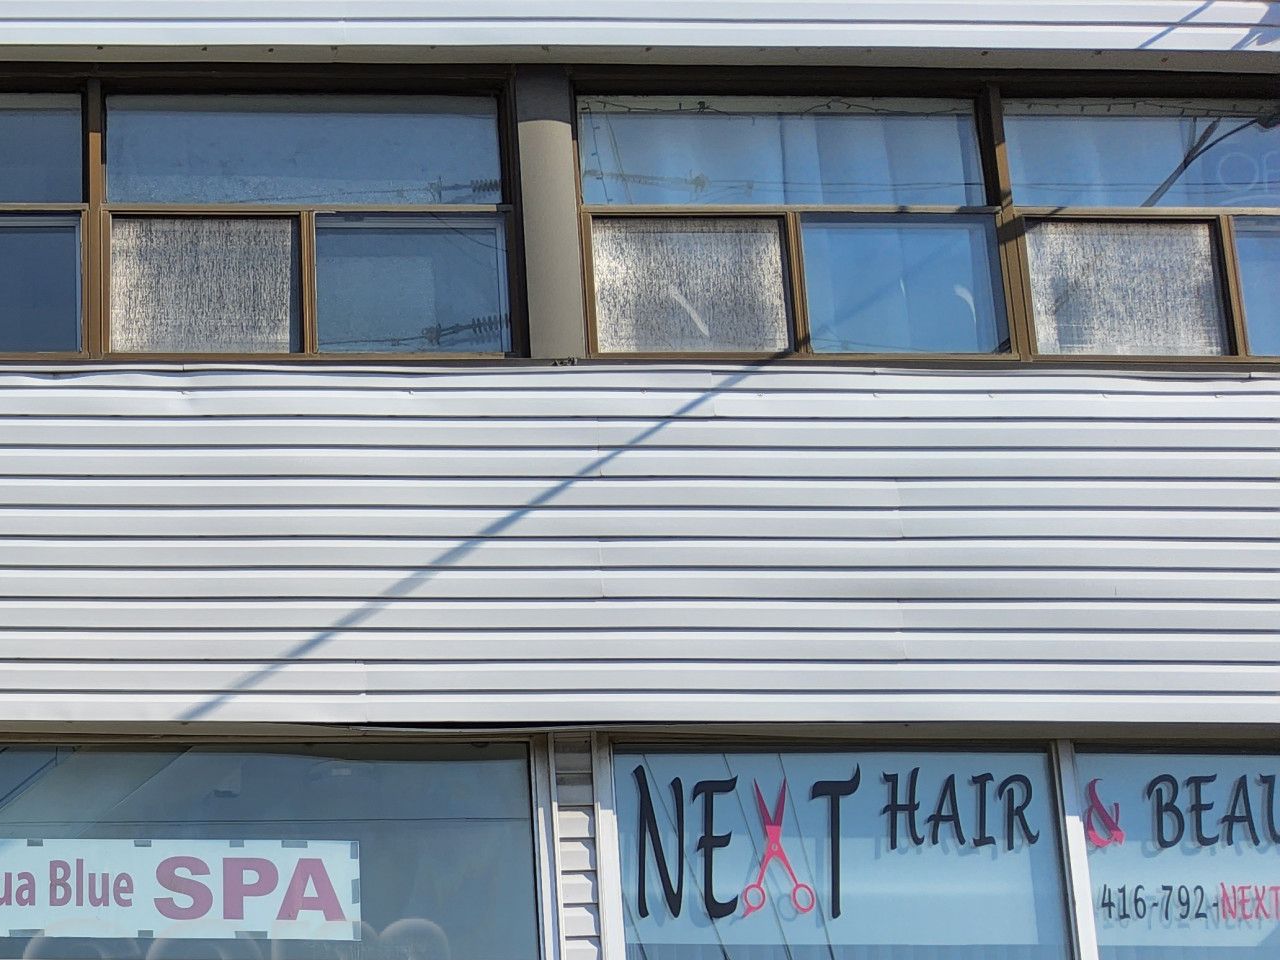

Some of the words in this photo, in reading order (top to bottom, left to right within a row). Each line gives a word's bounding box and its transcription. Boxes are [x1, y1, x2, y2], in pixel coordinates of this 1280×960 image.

[882, 766, 1040, 850] HAIR
[1086, 777, 1126, 848] &
[48, 858, 135, 909] Blue
[153, 854, 347, 923] SPA
